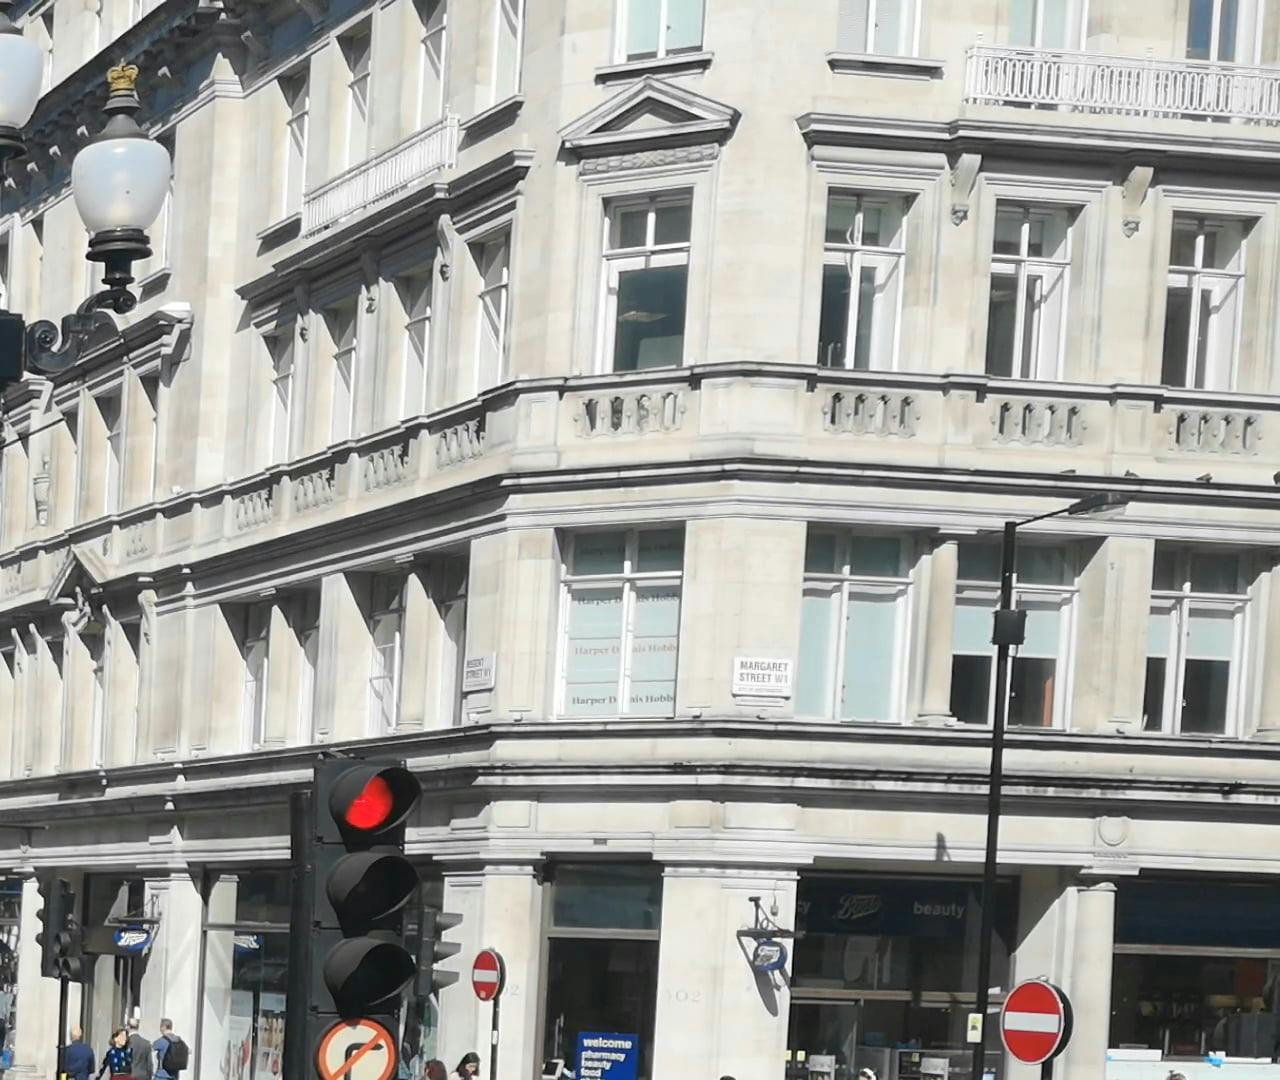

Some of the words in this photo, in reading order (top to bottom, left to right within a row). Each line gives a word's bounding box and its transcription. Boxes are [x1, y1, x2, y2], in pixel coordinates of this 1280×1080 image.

[740, 660, 788, 671] MARGARET
[739, 672, 771, 682] STREET
[572, 696, 606, 706] Harper
[914, 901, 966, 920] beauty
[583, 1037, 633, 1049] welcome
[581, 1050, 626, 1063] pharmacy
[581, 1060, 613, 1070] beauty
